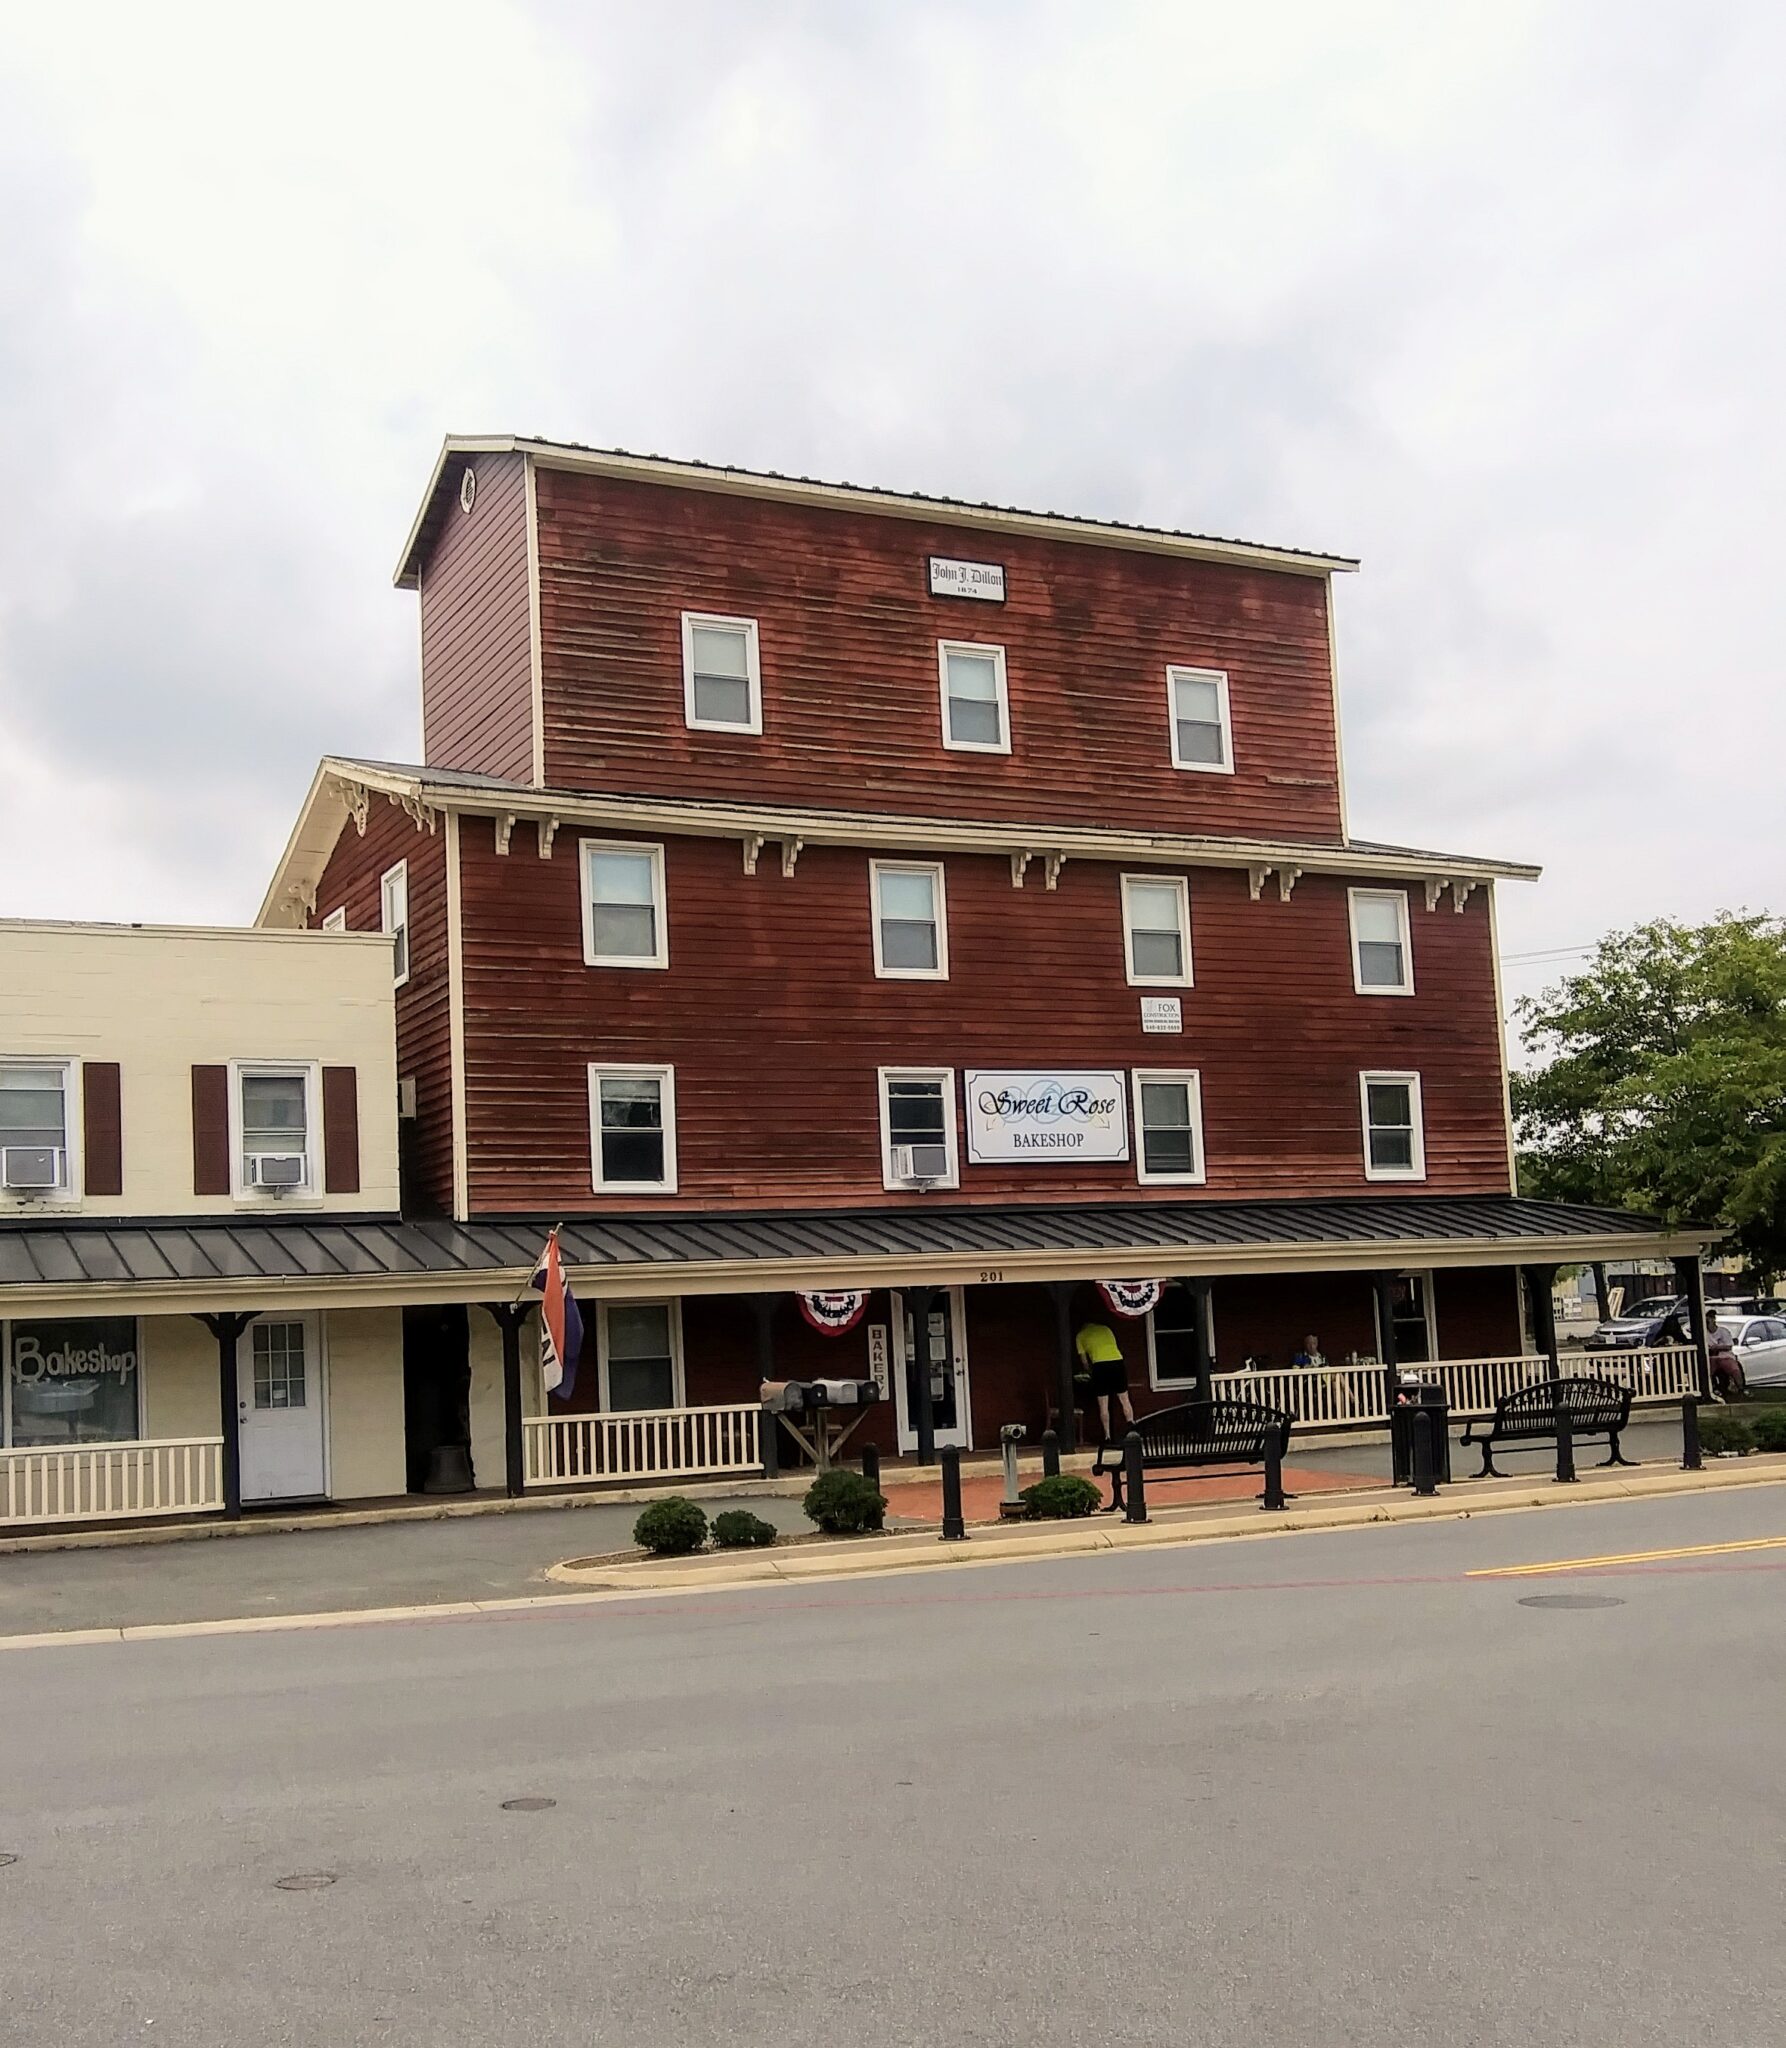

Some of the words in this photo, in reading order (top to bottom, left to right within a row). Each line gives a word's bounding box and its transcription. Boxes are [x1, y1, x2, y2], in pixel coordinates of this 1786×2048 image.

[932, 562, 957, 583] John
[958, 566, 969, 584] J.
[970, 568, 1002, 586] Dillon
[957, 586, 978, 594] 1874
[1158, 1003, 1176, 1012] FOX
[978, 1090, 1052, 1115] Sweet
[1057, 1090, 1116, 1115] Rose
[1013, 1133, 1084, 1148] BAKESHOP
[980, 1271, 1003, 1282] 201
[11, 1336, 137, 1386] Bakeshop
